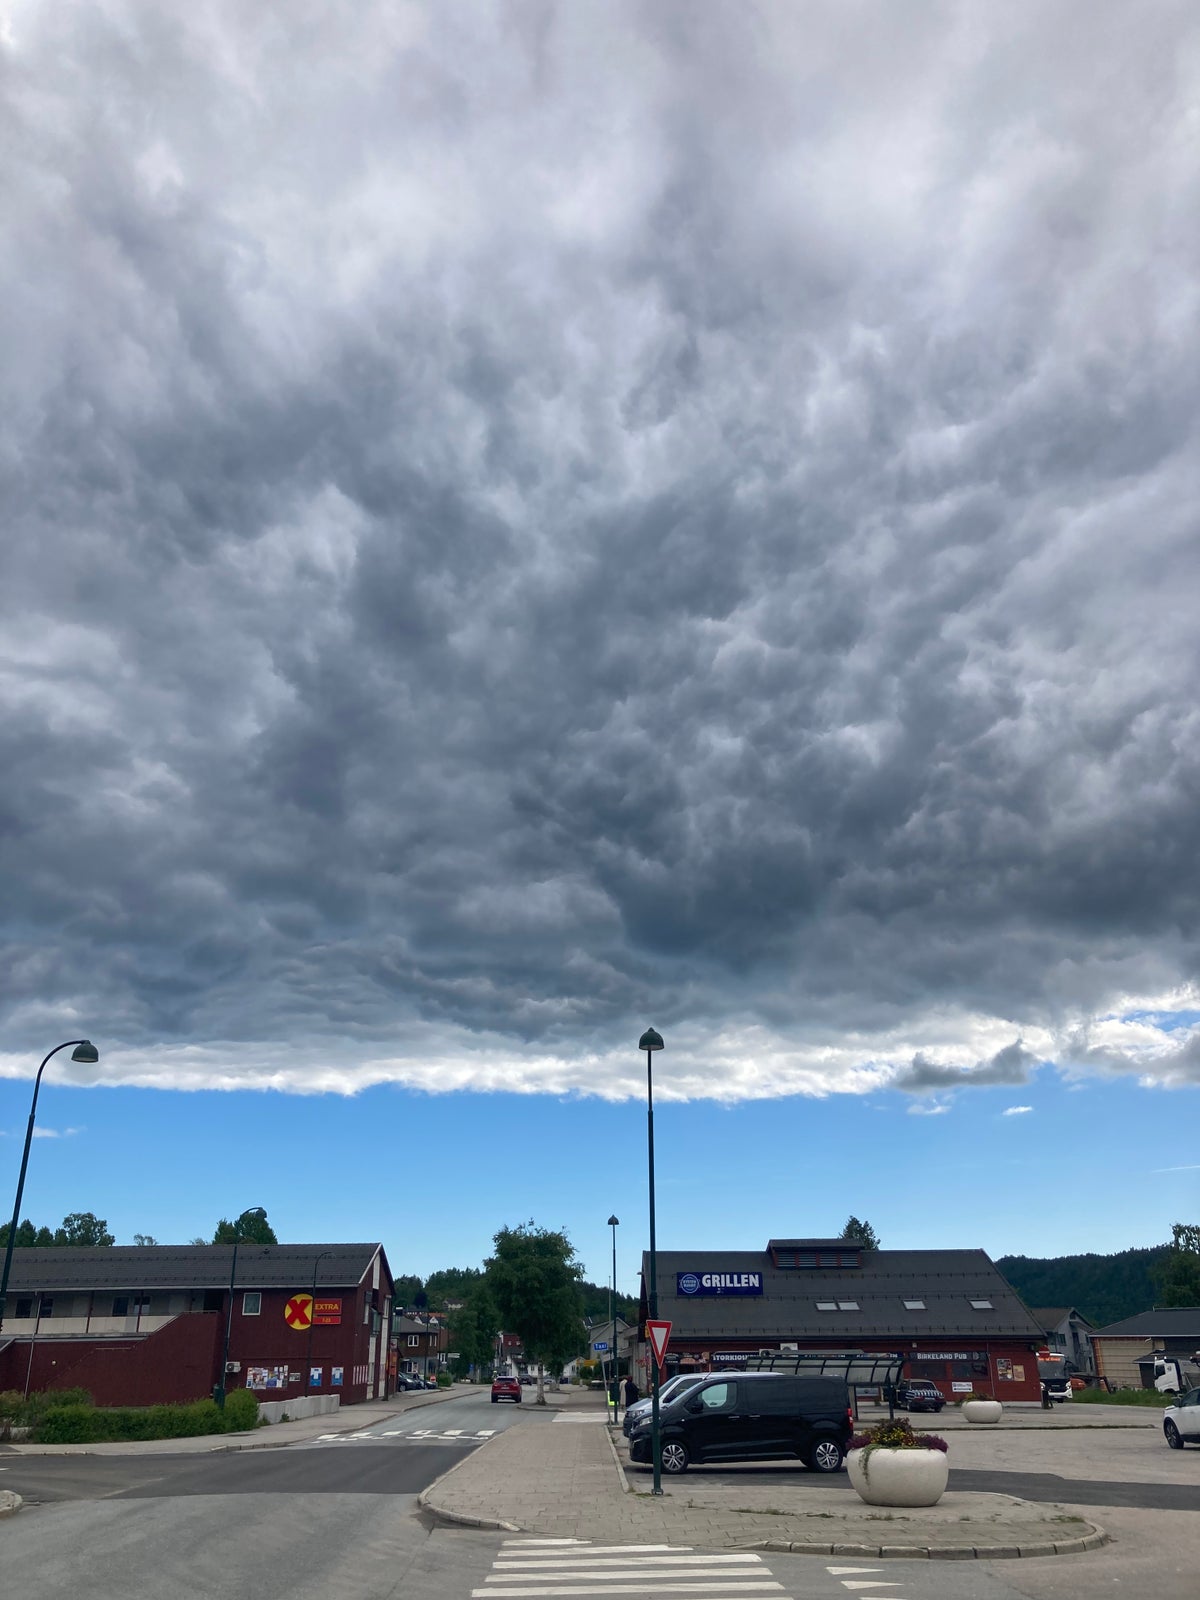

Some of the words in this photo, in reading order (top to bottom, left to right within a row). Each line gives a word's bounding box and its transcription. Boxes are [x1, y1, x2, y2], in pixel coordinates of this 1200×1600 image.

[701, 1274, 760, 1287] GRILLEN
[917, 1352, 952, 1360] BIRKELAND
[954, 1352, 967, 1360] PUB
